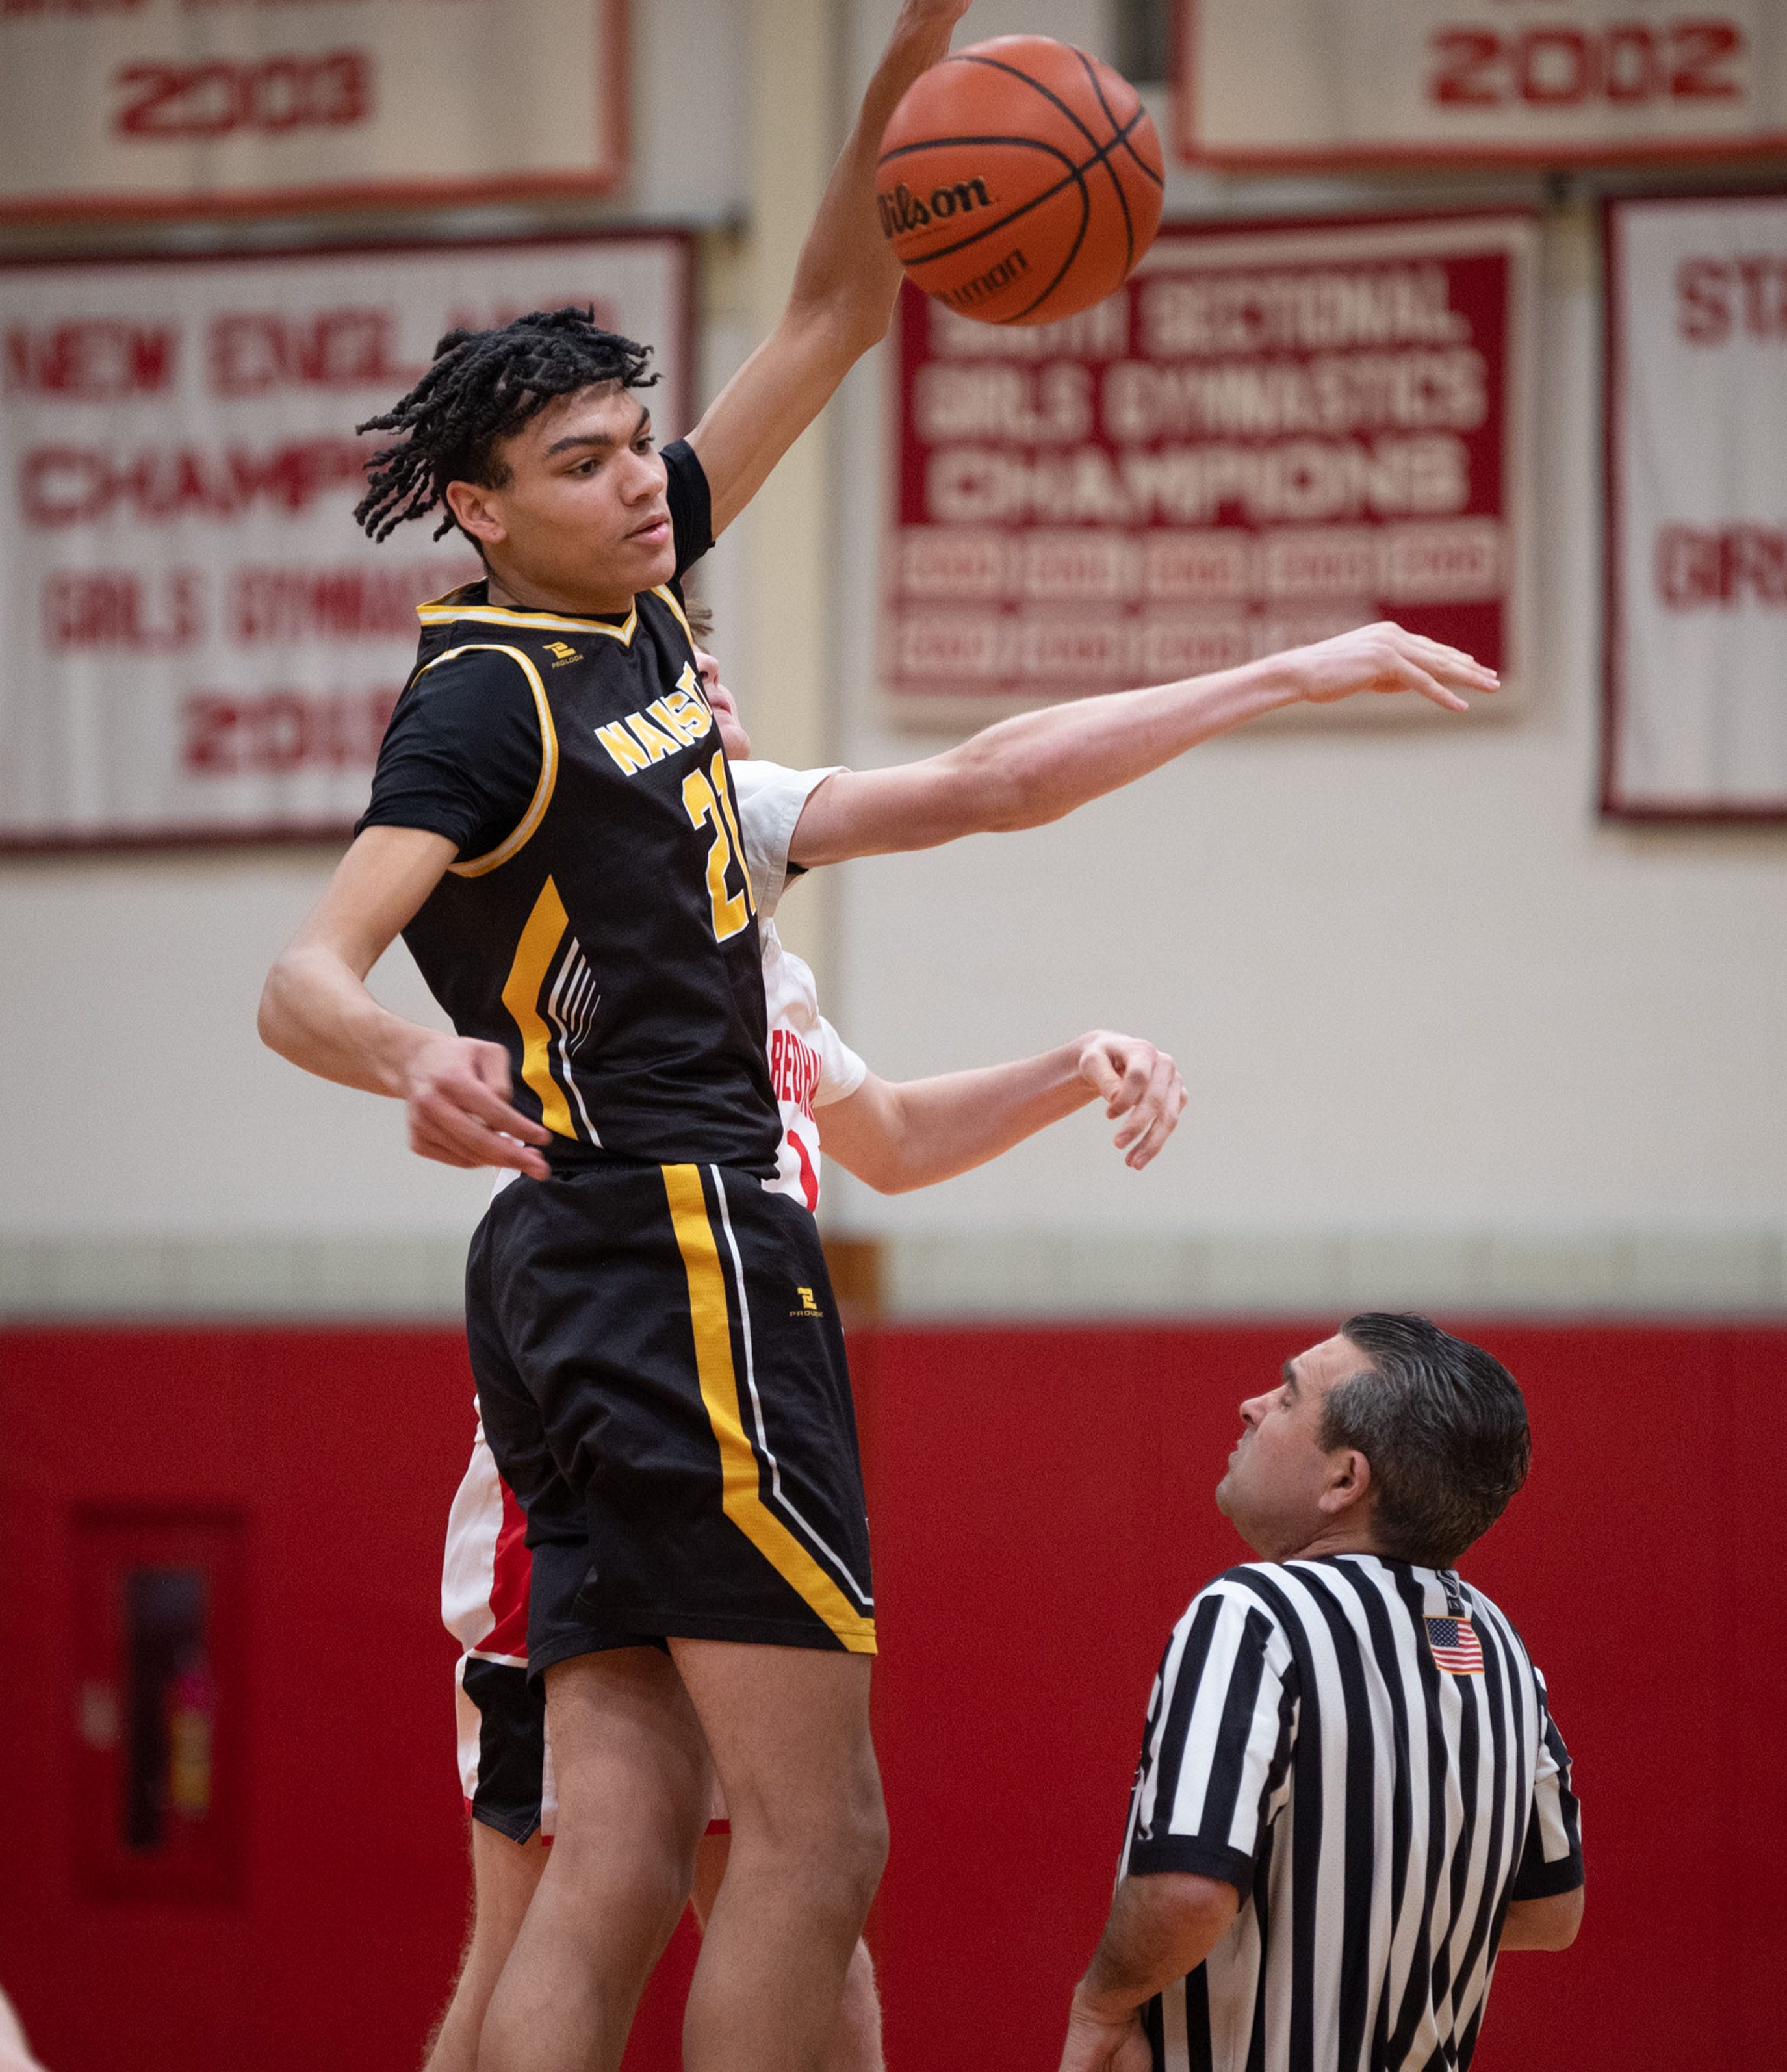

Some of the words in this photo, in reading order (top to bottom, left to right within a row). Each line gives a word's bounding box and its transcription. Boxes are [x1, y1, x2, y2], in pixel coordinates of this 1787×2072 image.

[1433, 19, 1745, 107] 2002
[928, 435, 1470, 520] CHAMPIONS
[682, 748, 756, 944] 21
